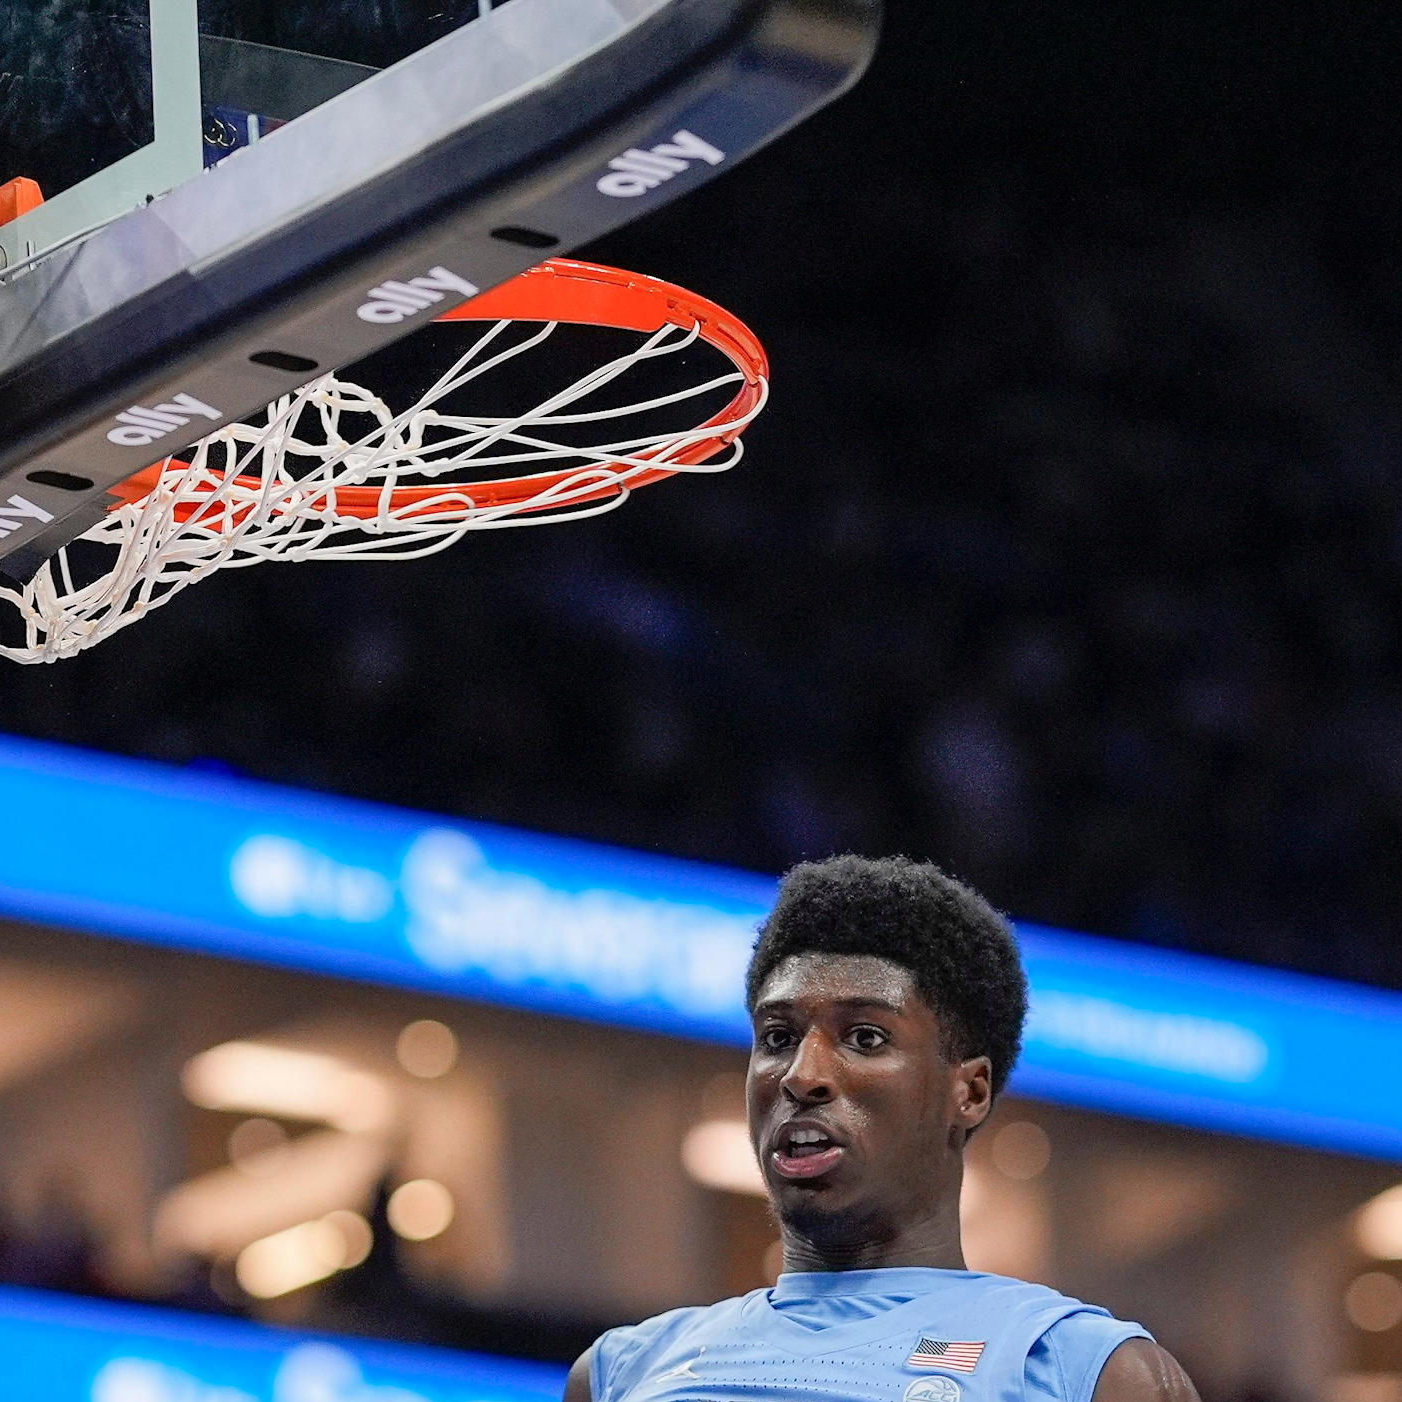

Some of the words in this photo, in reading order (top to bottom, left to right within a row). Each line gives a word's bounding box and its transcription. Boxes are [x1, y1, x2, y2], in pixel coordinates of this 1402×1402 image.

[596, 129, 726, 198] ally
[356, 265, 480, 324] ally
[106, 392, 223, 447] ally
